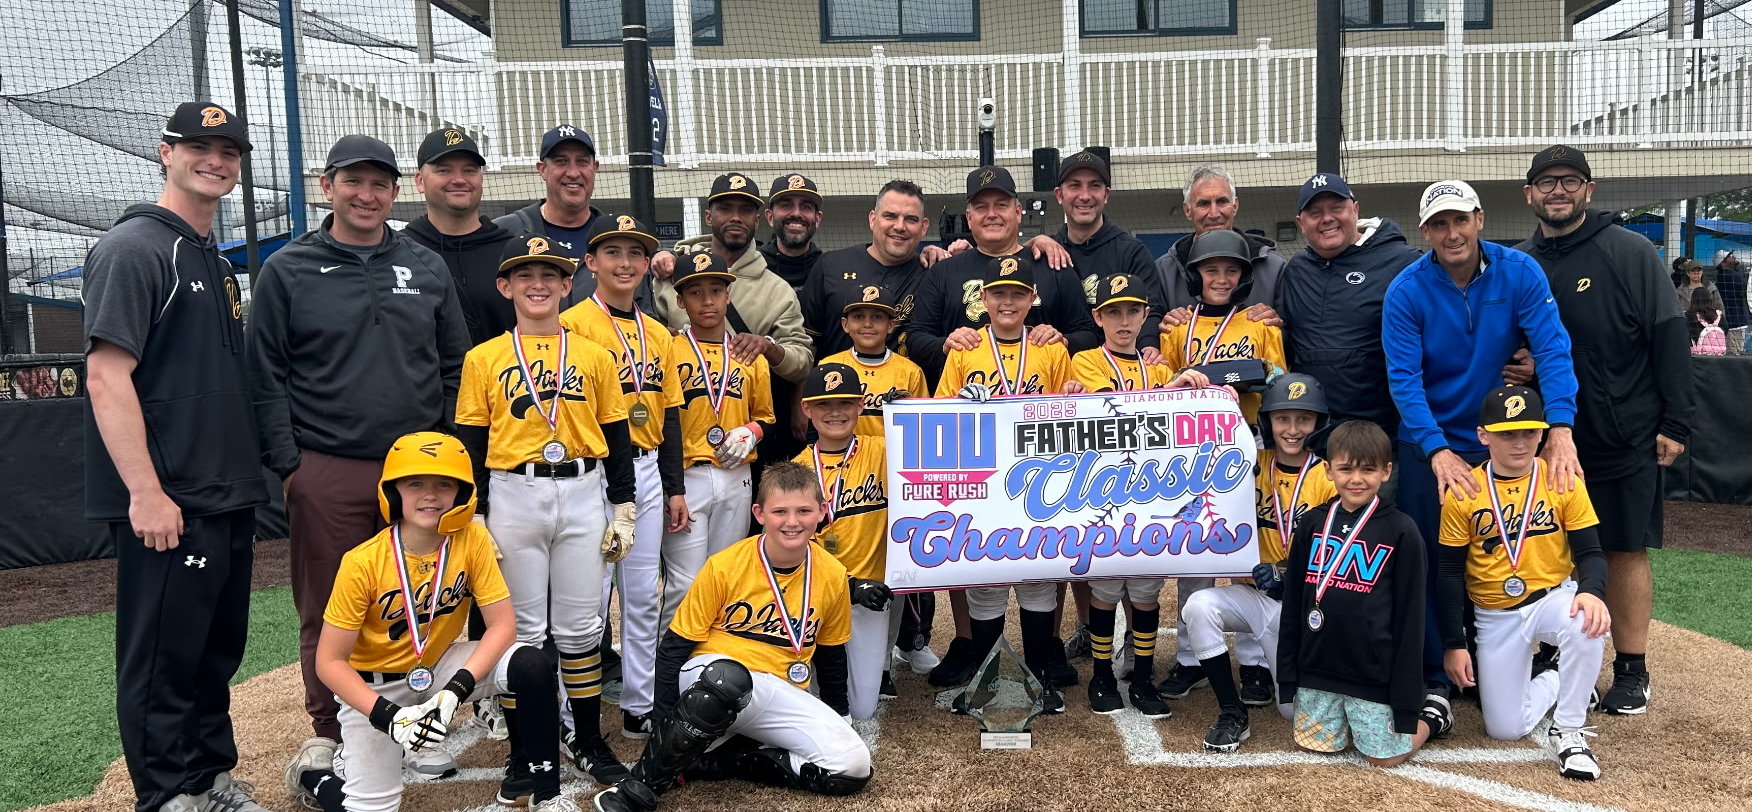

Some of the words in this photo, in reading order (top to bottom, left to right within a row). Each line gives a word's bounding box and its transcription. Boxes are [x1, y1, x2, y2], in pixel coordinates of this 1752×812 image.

[660, 226, 678, 236] HERE
[392, 265, 412, 288] P
[1124, 391, 1184, 403] DIAMOND
[1023, 401, 1077, 420] 2025
[893, 412, 997, 469] 10U
[1015, 413, 1169, 456] FATHER'S
[1173, 412, 1239, 448] DAY
[923, 473, 957, 481] POWERED
[959, 473, 968, 481] BY
[1004, 441, 1251, 522] Classic
[903, 483, 944, 500] PURE
[947, 482, 988, 500] RUSH
[891, 510, 1252, 574] Champions
[1335, 580, 1373, 593] NATION
